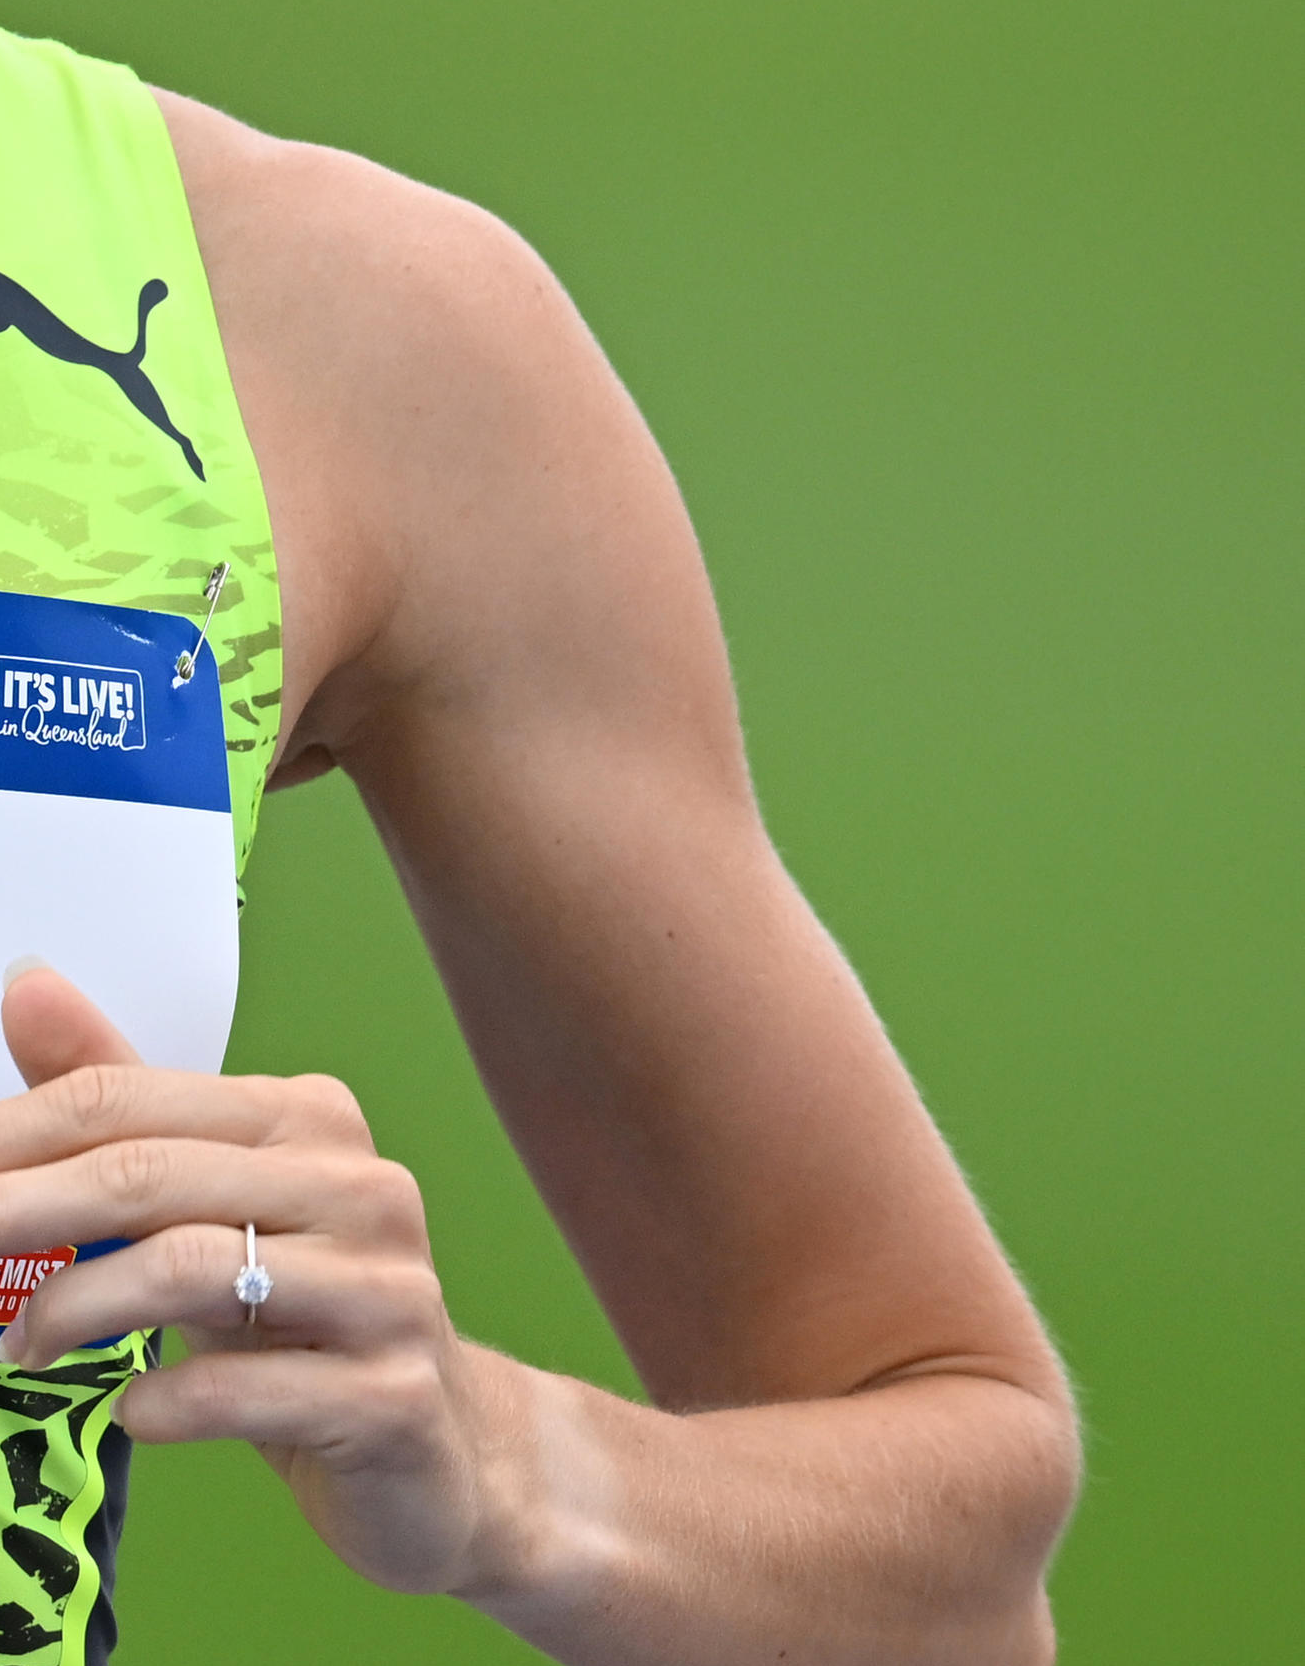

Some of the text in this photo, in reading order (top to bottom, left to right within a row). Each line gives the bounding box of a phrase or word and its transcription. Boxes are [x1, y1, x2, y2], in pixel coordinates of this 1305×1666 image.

[62, 676, 135, 721] LIVE!
[2, 704, 128, 751] in Queensland
